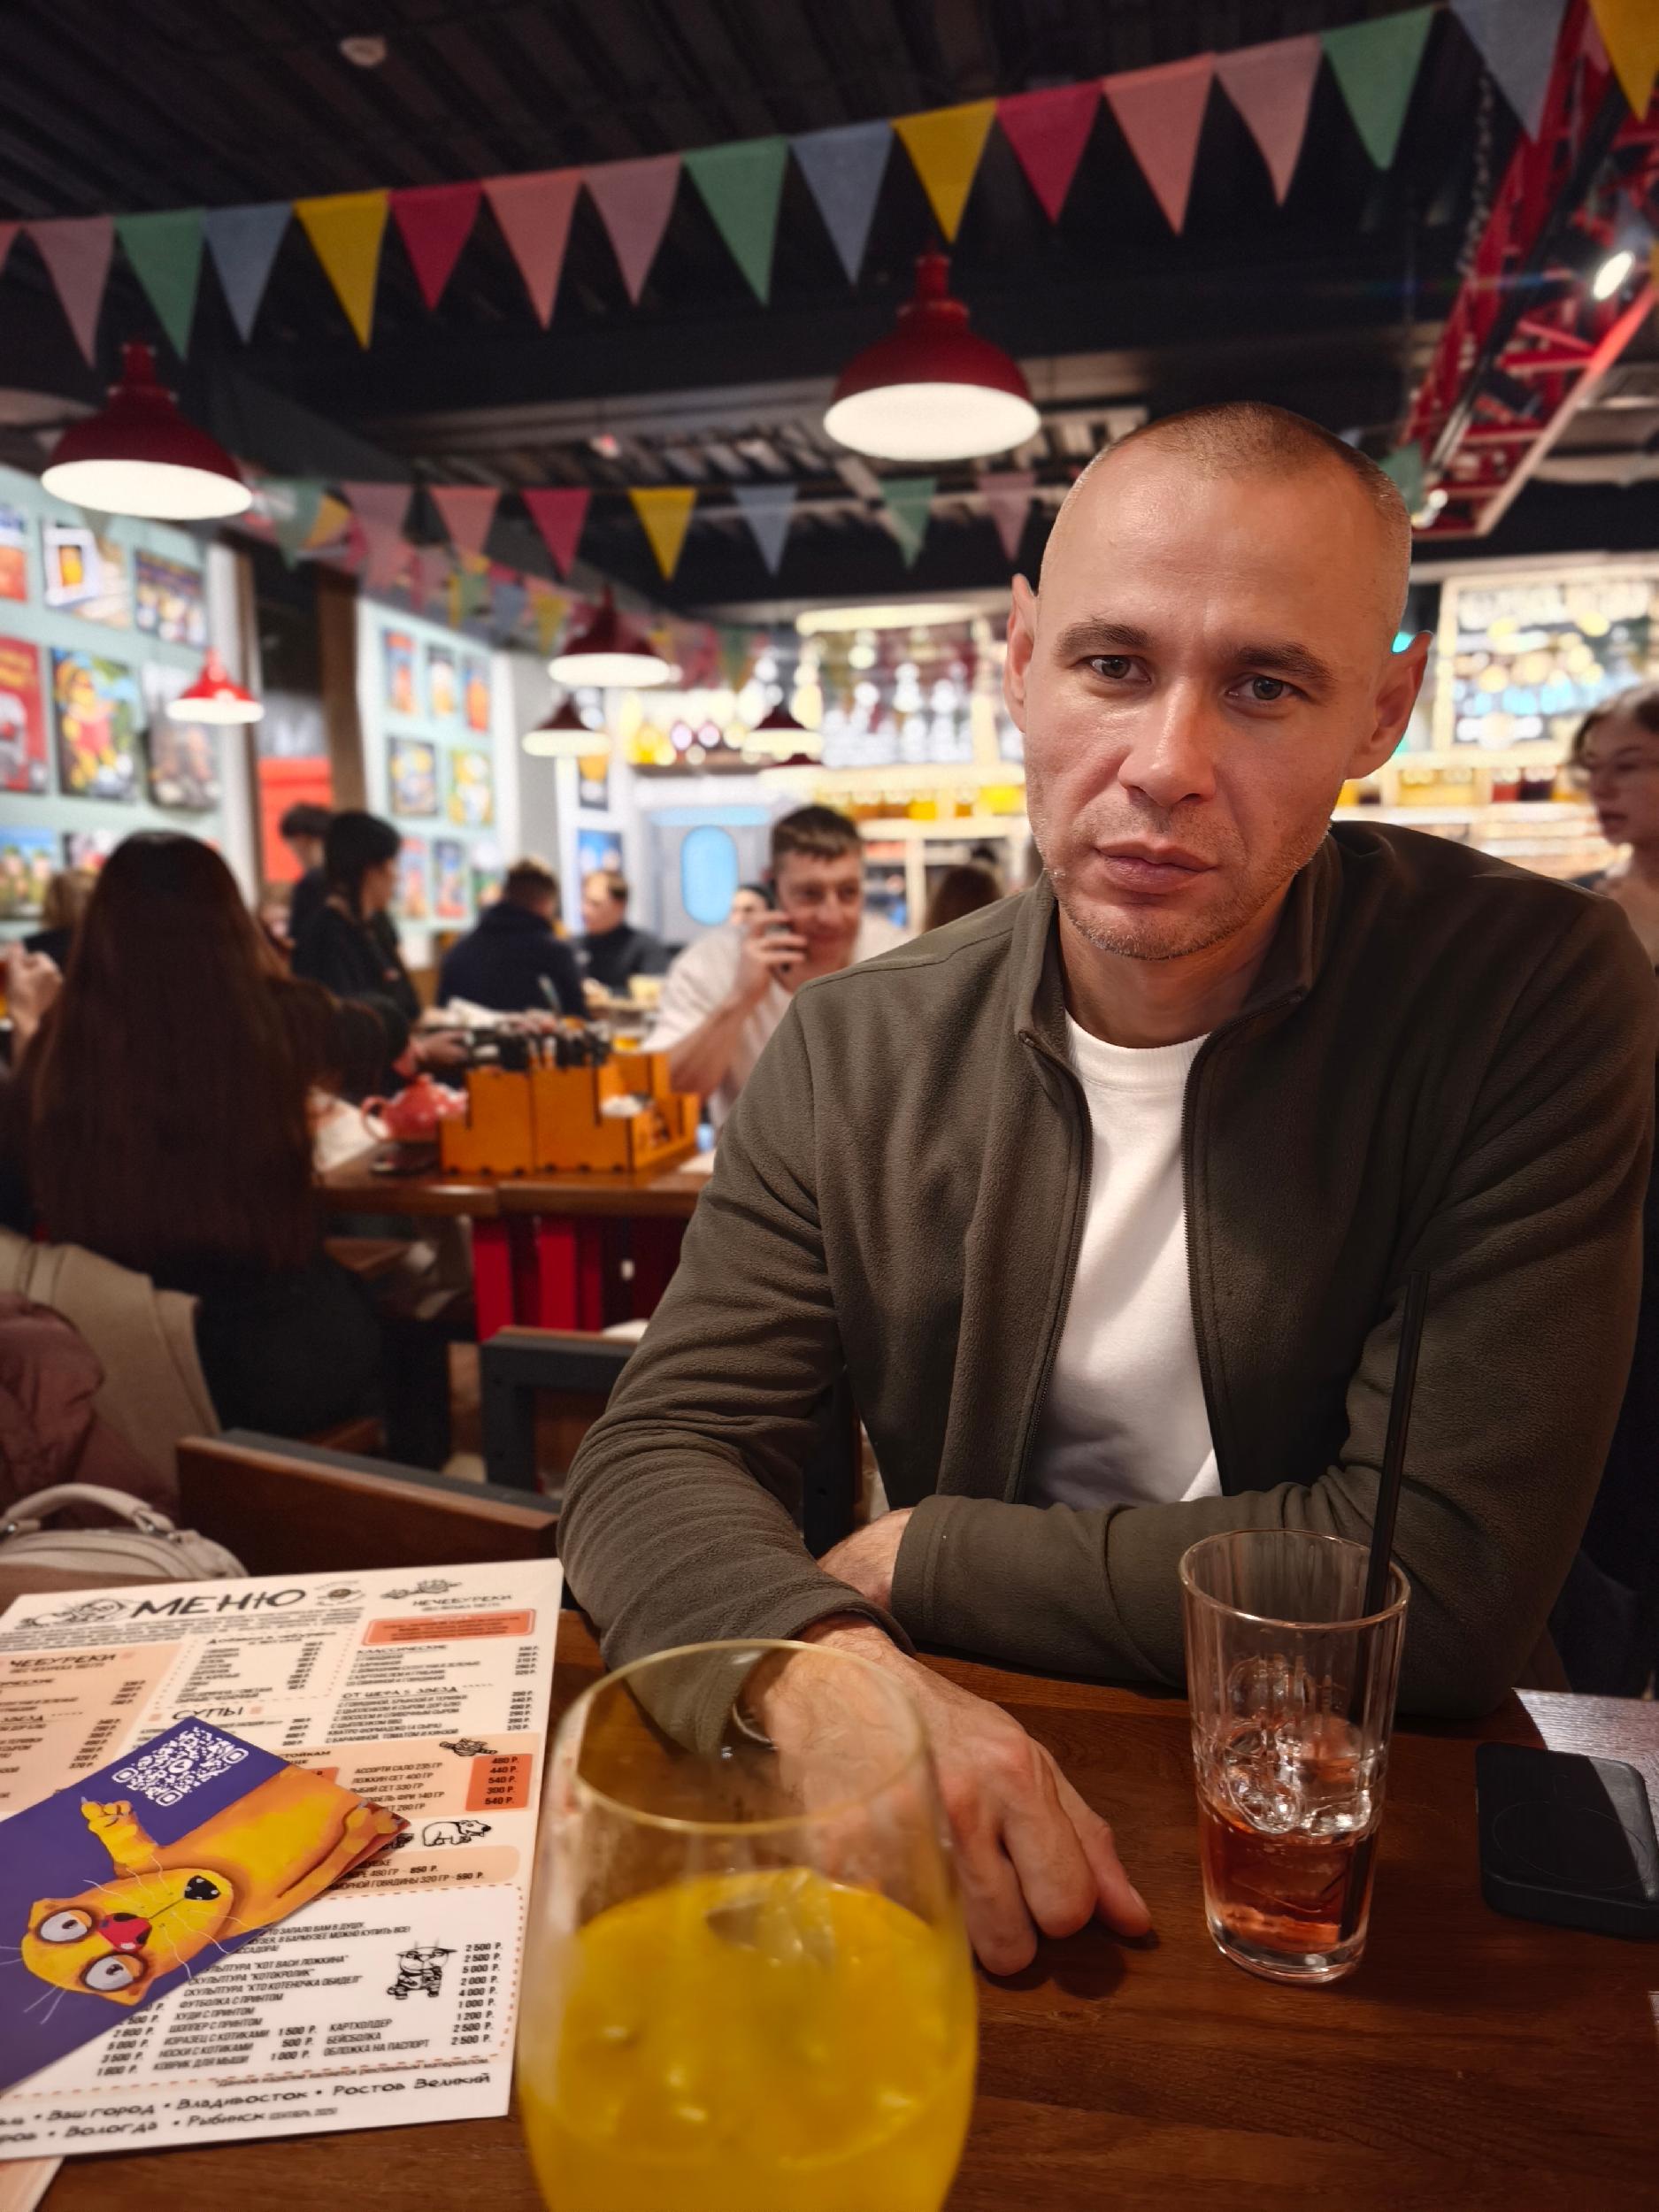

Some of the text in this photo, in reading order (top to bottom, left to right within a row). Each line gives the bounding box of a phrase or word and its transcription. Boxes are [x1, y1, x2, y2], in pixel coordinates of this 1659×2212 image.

[130, 1589, 306, 1617] МЕНЮ
[11, 1655, 116, 1667] ЧЕБУРЕКИ
[172, 1707, 243, 1720] СУПЫ
[471, 1964, 488, 1973] 000
[184, 1985, 243, 1997] СКУЛЬПТУРА
[467, 1987, 485, 1996] 000
[179, 1997, 230, 2008] ФУТБОЛКА
[240, 1993, 283, 2003] ПРИНТОМ
[211, 2007, 255, 2017] ПРИНТОМ
[218, 2017, 263, 2028] ПРИНТОМ
[462, 2023, 480, 2032] 500
[460, 2035, 479, 2044] 500
[48, 2073, 490, 2122] Ваш город Владивосток Ростов Великий
[65, 2113, 266, 2138] Вологда Рыбинск
